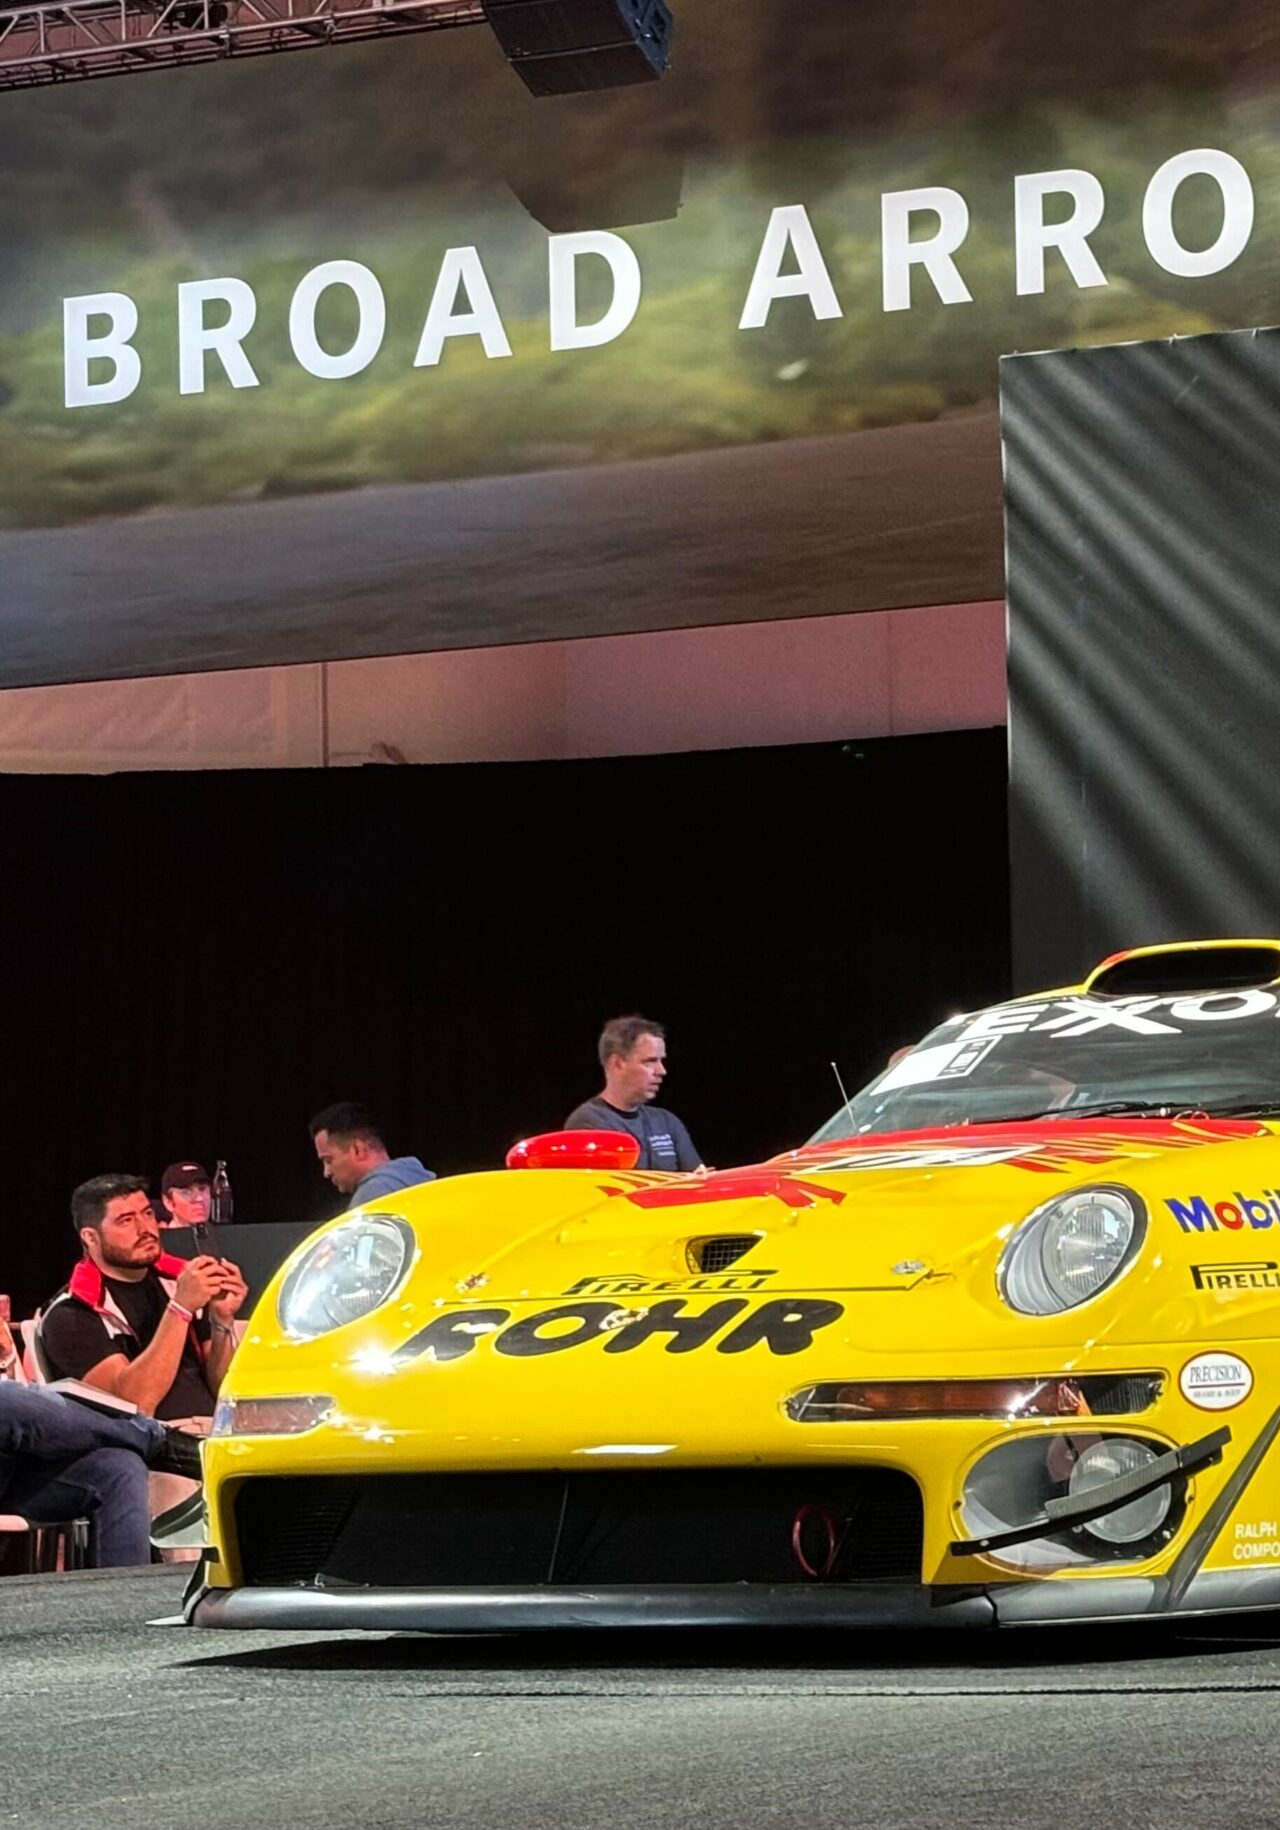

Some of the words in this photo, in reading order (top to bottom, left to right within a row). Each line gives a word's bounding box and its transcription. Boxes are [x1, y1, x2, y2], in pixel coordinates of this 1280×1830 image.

[63, 230, 641, 408] BROAD
[561, 1269, 778, 1295] PIRELLI
[392, 1298, 845, 1361] ROHR
[1190, 1365, 1242, 1383] PRECISION
[1235, 1522, 1277, 1539] RALPH
